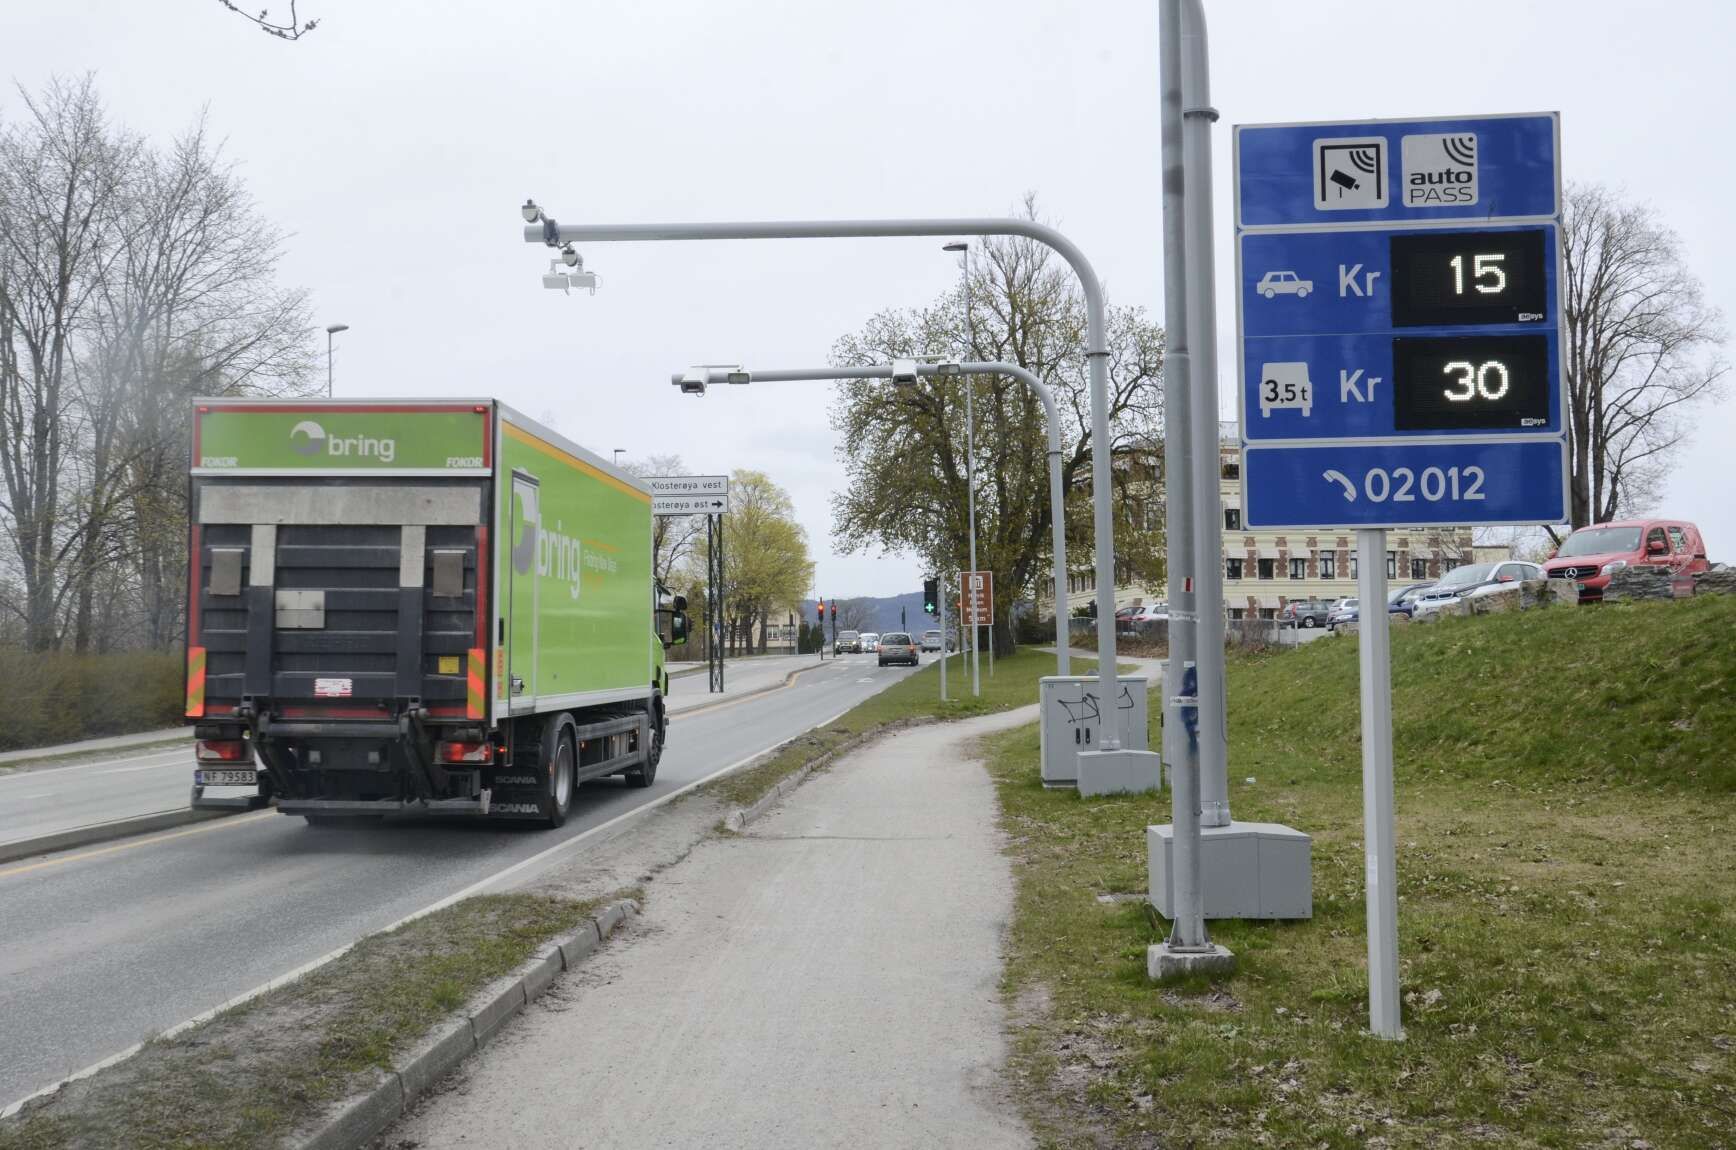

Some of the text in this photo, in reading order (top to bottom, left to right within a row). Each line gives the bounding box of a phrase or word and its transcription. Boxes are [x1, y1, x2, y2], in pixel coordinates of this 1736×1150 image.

[1410, 168, 1473, 186] auto
[1410, 187, 1473, 203] PASS
[1339, 264, 1381, 297] Kr
[1450, 254, 1506, 294] 15
[1264, 380, 1308, 404] 3,5 t
[1340, 369, 1382, 403] Kr
[1443, 361, 1509, 401] 30
[328, 434, 395, 462] bring
[536, 512, 581, 599] bring
[495, 775, 537, 785] SCANIA
